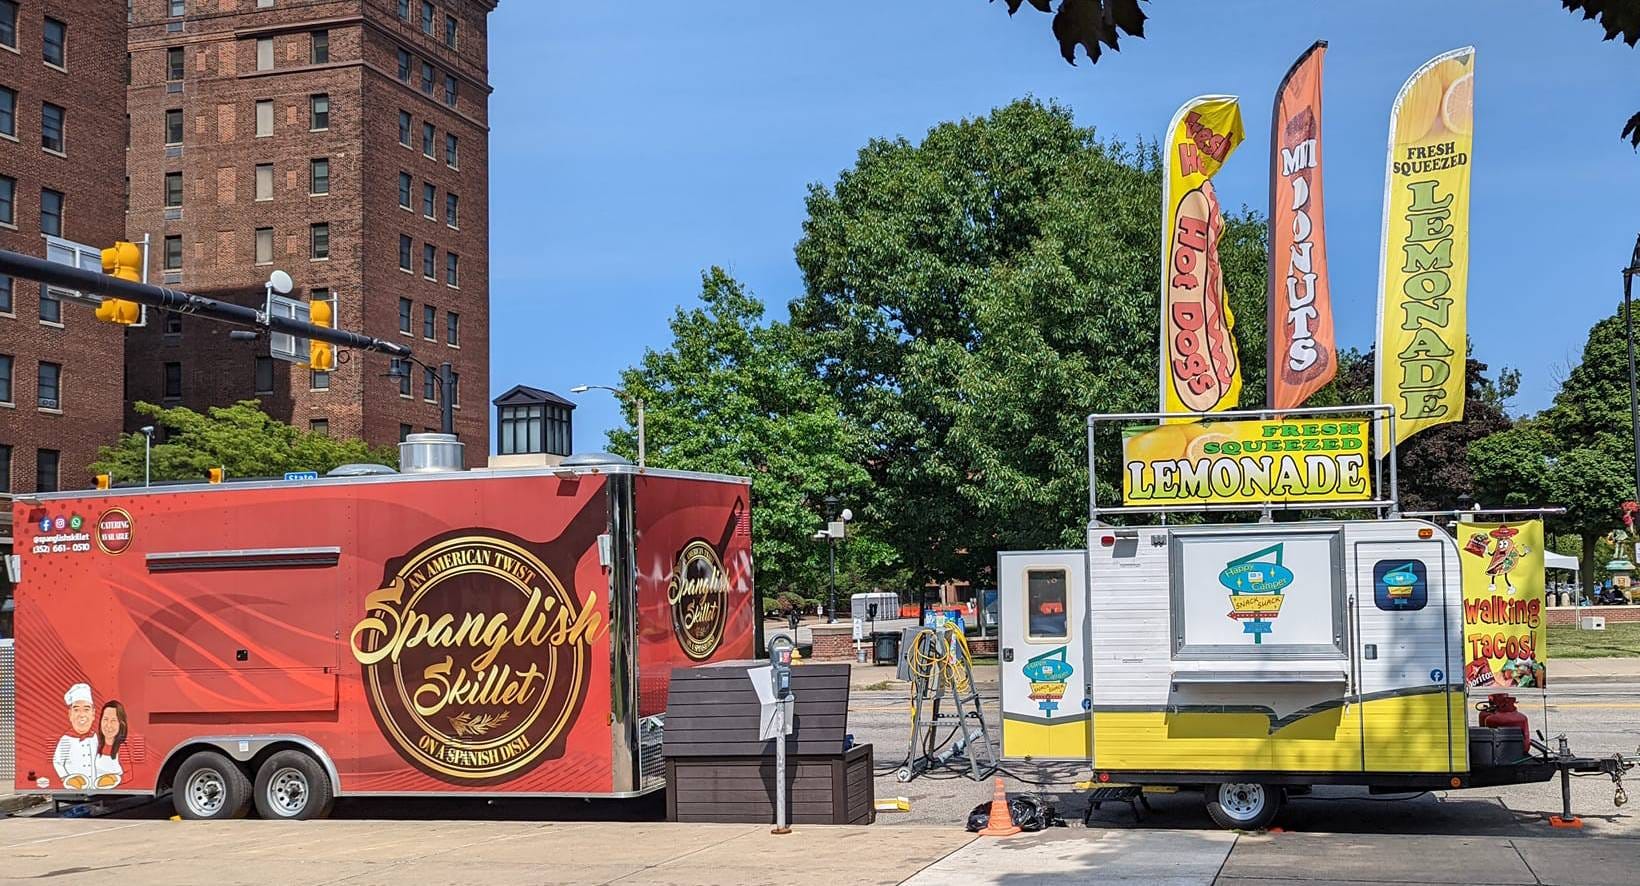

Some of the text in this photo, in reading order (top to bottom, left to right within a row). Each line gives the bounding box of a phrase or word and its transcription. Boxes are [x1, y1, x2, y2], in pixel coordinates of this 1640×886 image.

[1392, 153, 1468, 176] SQUEEZED
[1407, 141, 1456, 160] FRESH
[1286, 175, 1318, 372] DONUTS
[1172, 215, 1216, 396] Hot Dogs
[1397, 179, 1454, 420] LEMONADE
[1262, 423, 1361, 438] FRESH
[1203, 438, 1363, 455] SQUEEZED
[1127, 454, 1367, 500] LEMONADE
[100, 520, 129, 530] CATERING
[32, 545, 50, 553] (352)
[72, 543, 90, 551] 0510
[408, 549, 537, 591] AN AMERICAN TWIST
[667, 562, 731, 606] Spanglish
[1225, 563, 1254, 577] Happy
[1252, 578, 1287, 591] Camper
[684, 599, 719, 630] Skillet
[1236, 597, 1258, 609] SNACK
[350, 576, 610, 673] Spanglish
[413, 655, 545, 717] Skillet
[418, 734, 531, 766] ON A SPANISH DISH
